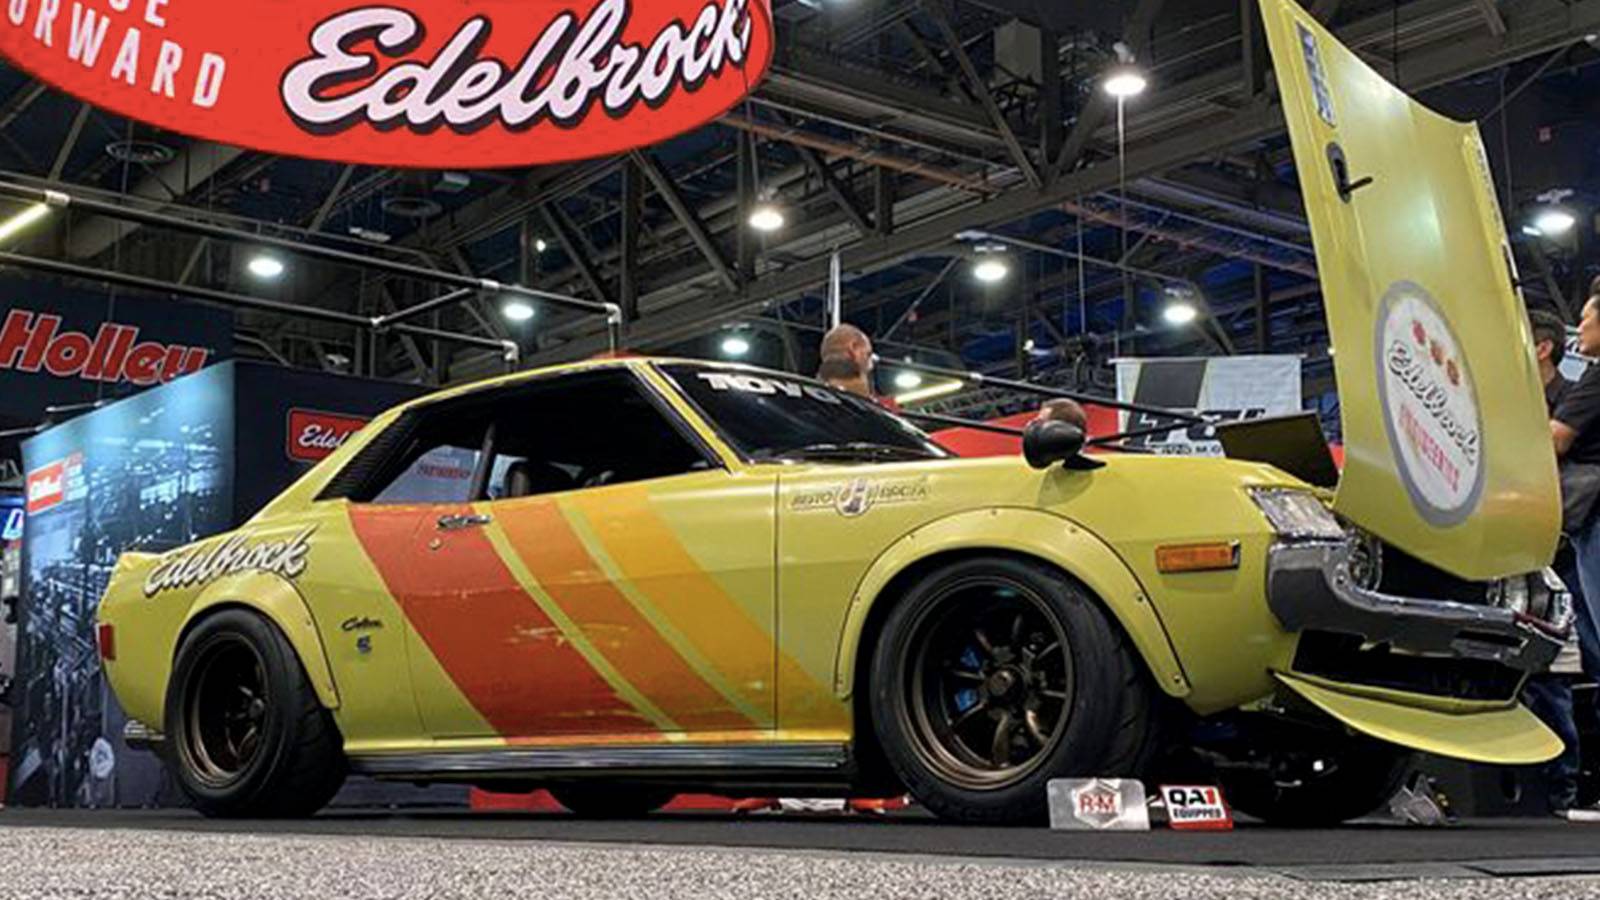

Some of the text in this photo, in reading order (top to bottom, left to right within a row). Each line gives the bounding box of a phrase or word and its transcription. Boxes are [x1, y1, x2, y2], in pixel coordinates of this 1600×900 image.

[280, 0, 752, 127] Edelbrock
[0, 309, 208, 385] Holley
[697, 373, 846, 405] TOYO
[143, 523, 318, 598] Edelbrock
[1169, 788, 1216, 806] QA1
